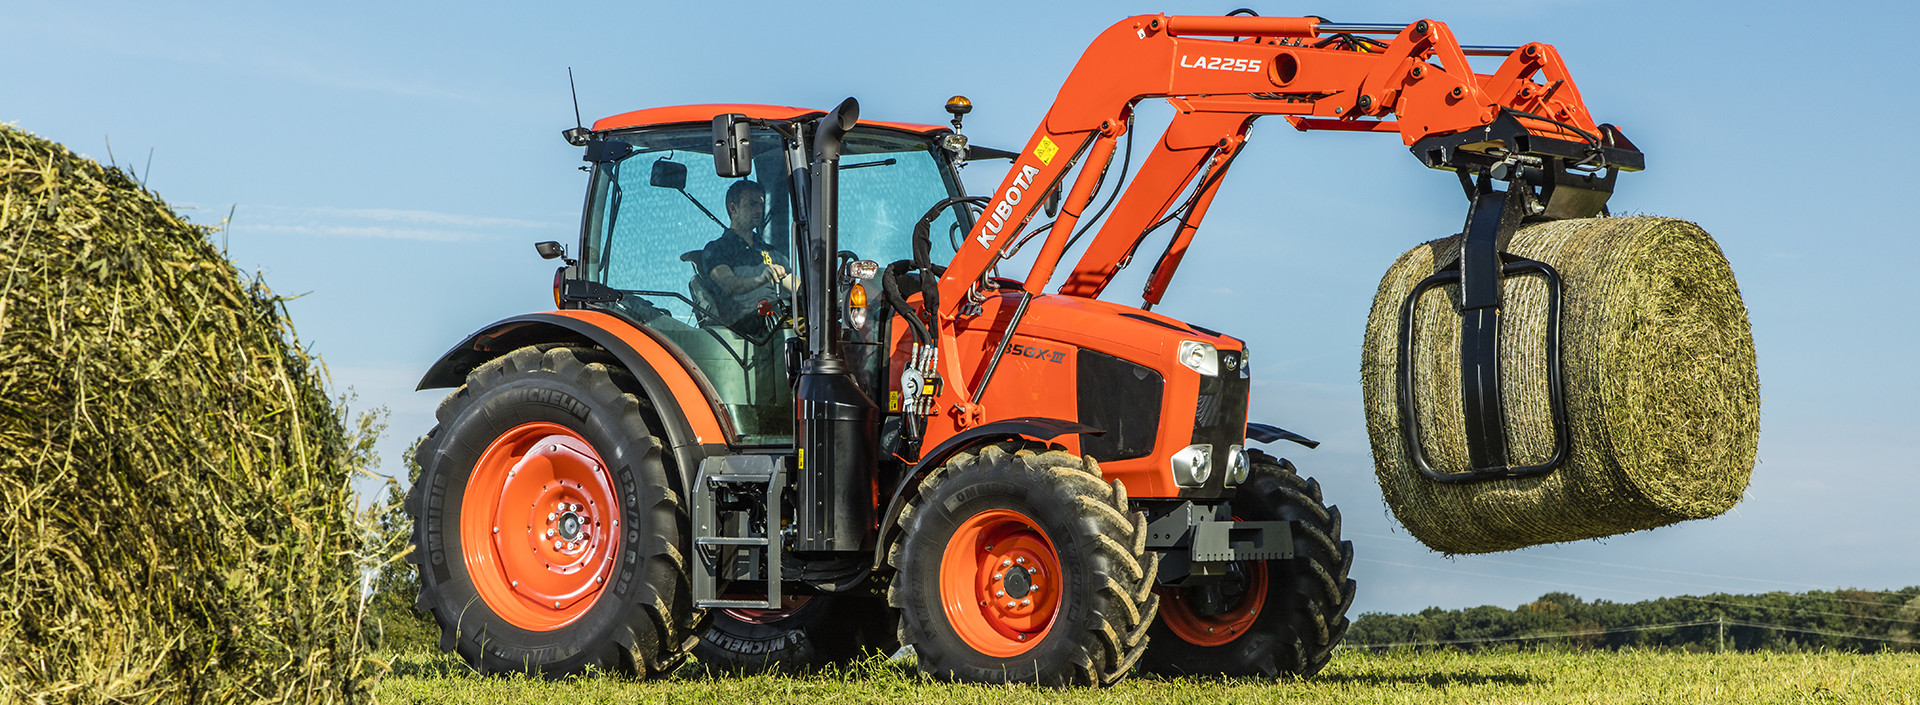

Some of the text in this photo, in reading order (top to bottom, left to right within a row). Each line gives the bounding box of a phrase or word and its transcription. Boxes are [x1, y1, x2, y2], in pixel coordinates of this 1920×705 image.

[1180, 55, 1262, 73] LA2255
[976, 164, 1040, 250] KUBOTA
[621, 470, 639, 543] 520/70
[625, 550, 636, 564] R
[704, 628, 786, 654] MICHELIN
